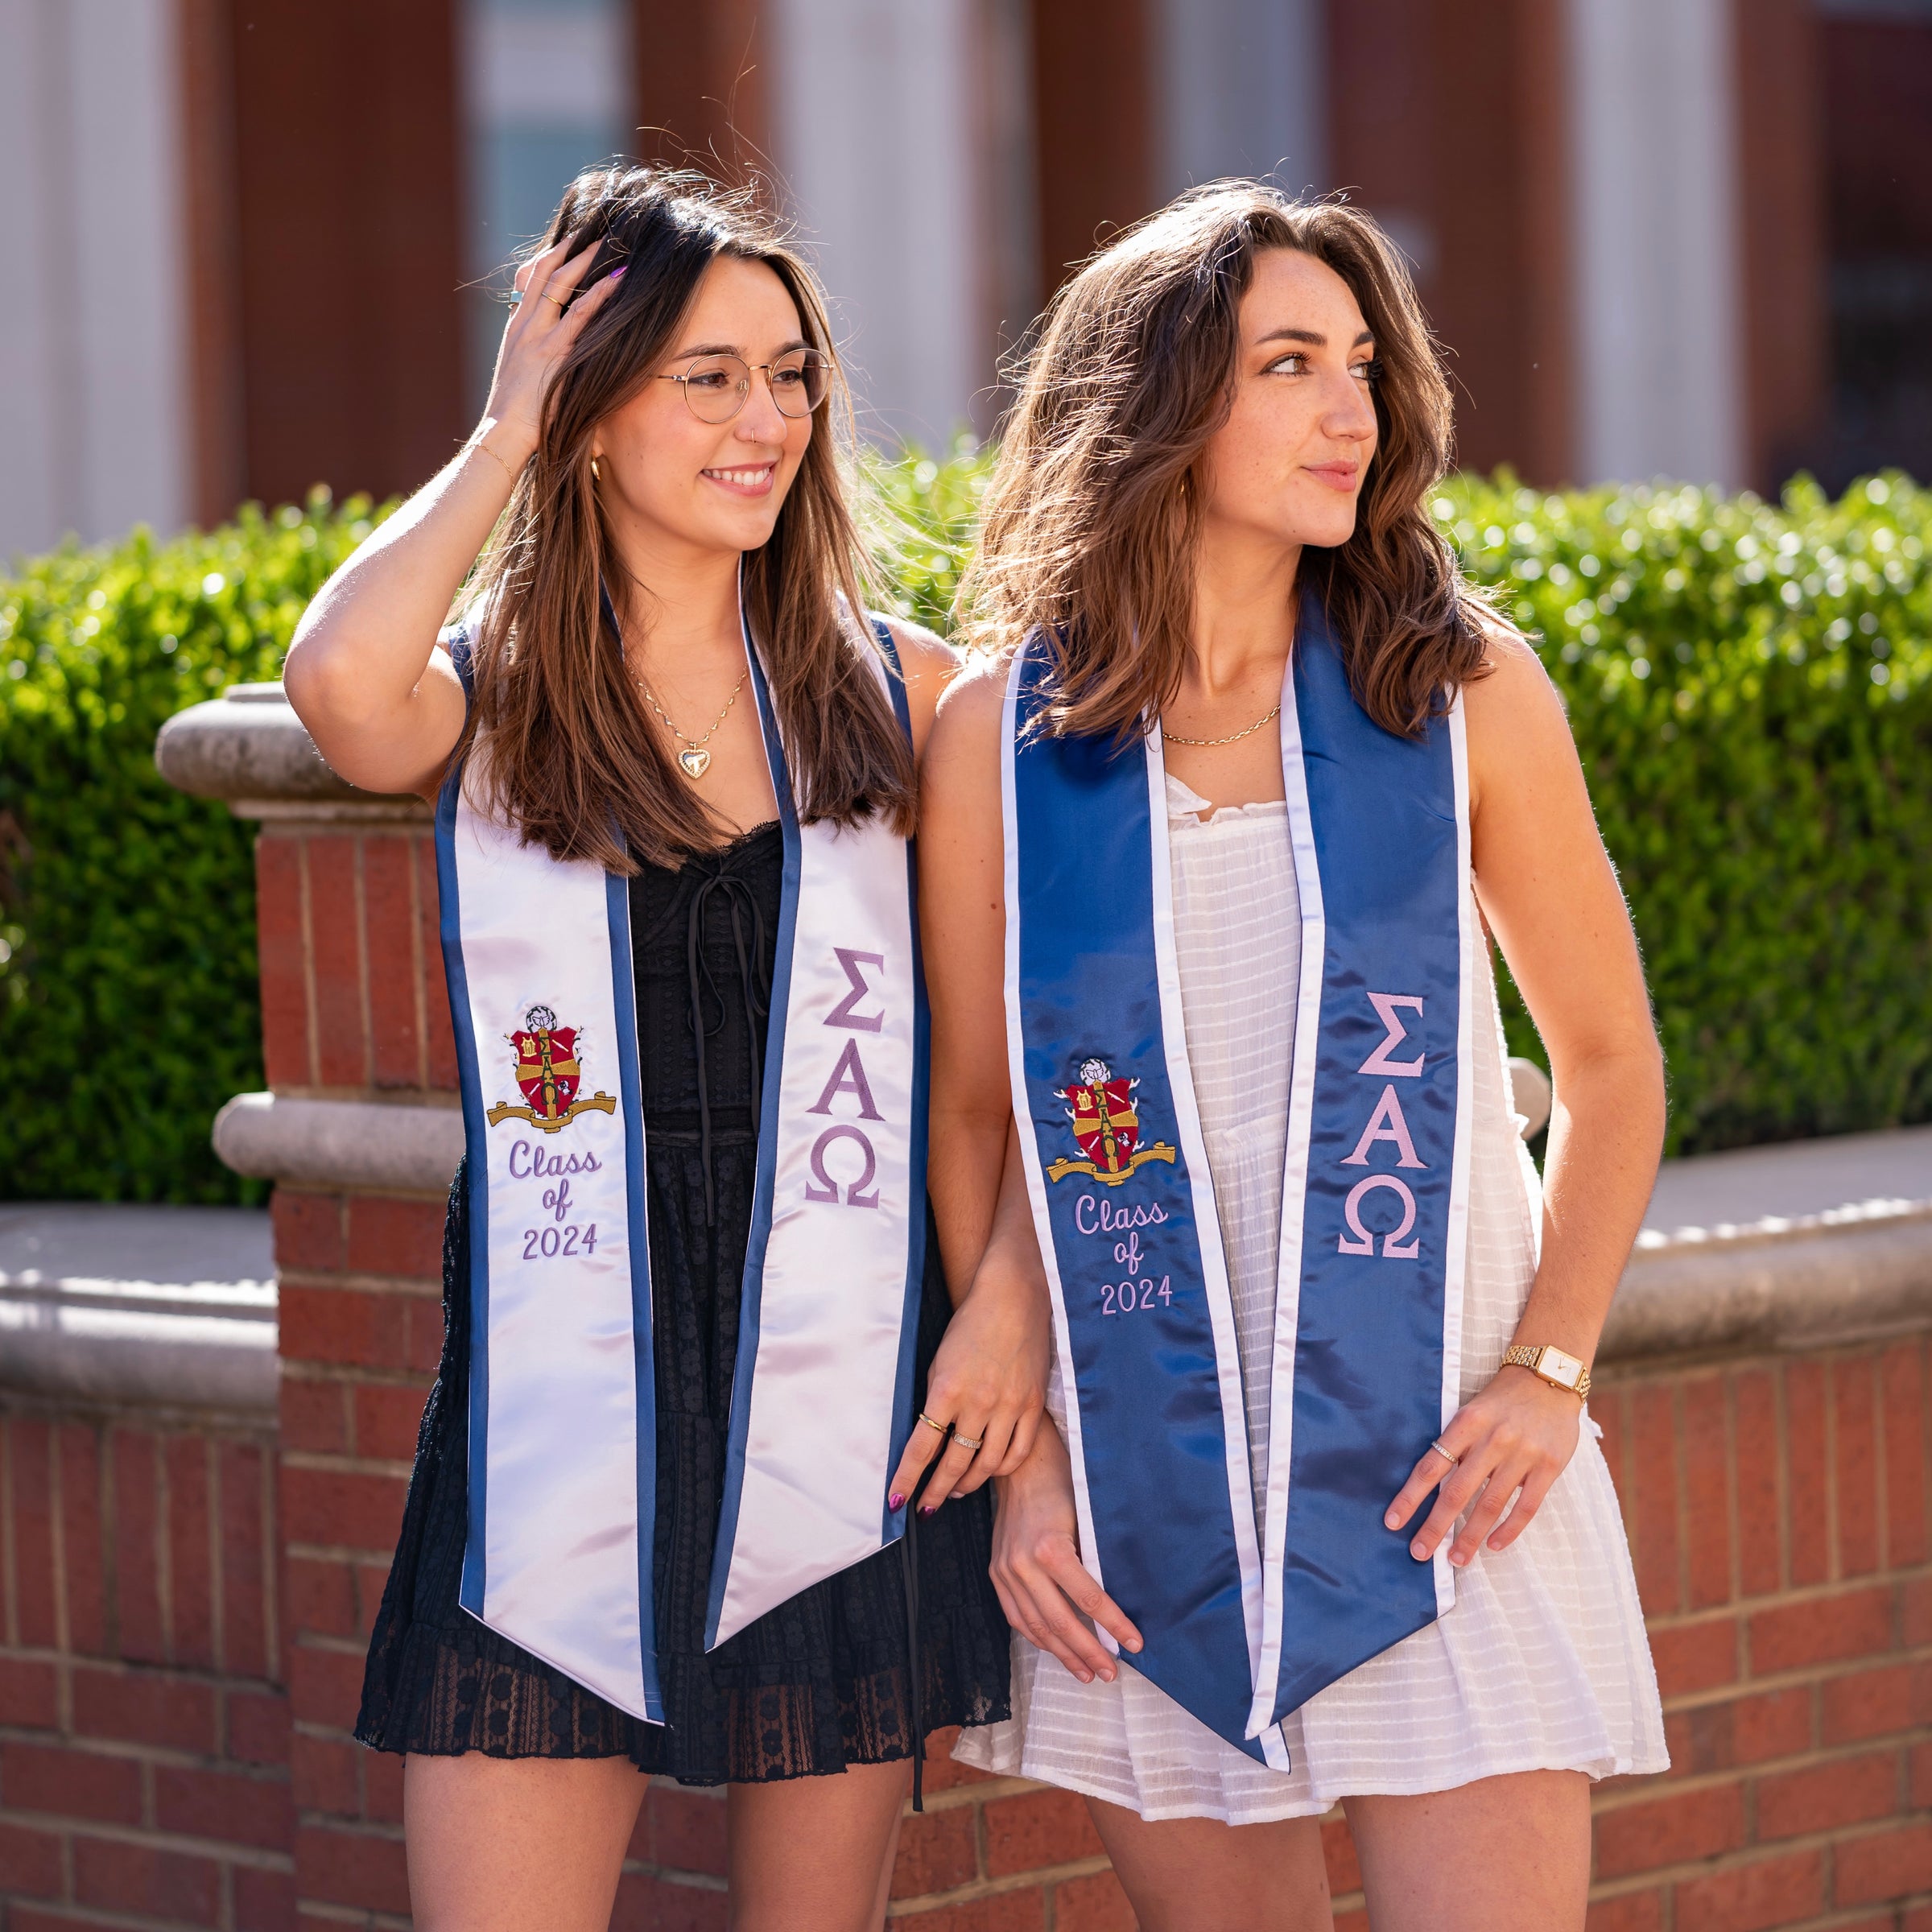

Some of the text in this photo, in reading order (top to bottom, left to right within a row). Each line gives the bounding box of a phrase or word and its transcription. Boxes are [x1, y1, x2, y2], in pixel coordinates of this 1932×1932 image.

[509, 1139, 603, 1179] Class
[542, 1178, 573, 1222] of
[1075, 1195, 1169, 1235] Class
[522, 1223, 597, 1261] 2024
[1113, 1231, 1144, 1276] of
[1100, 1274, 1173, 1315] 2024
